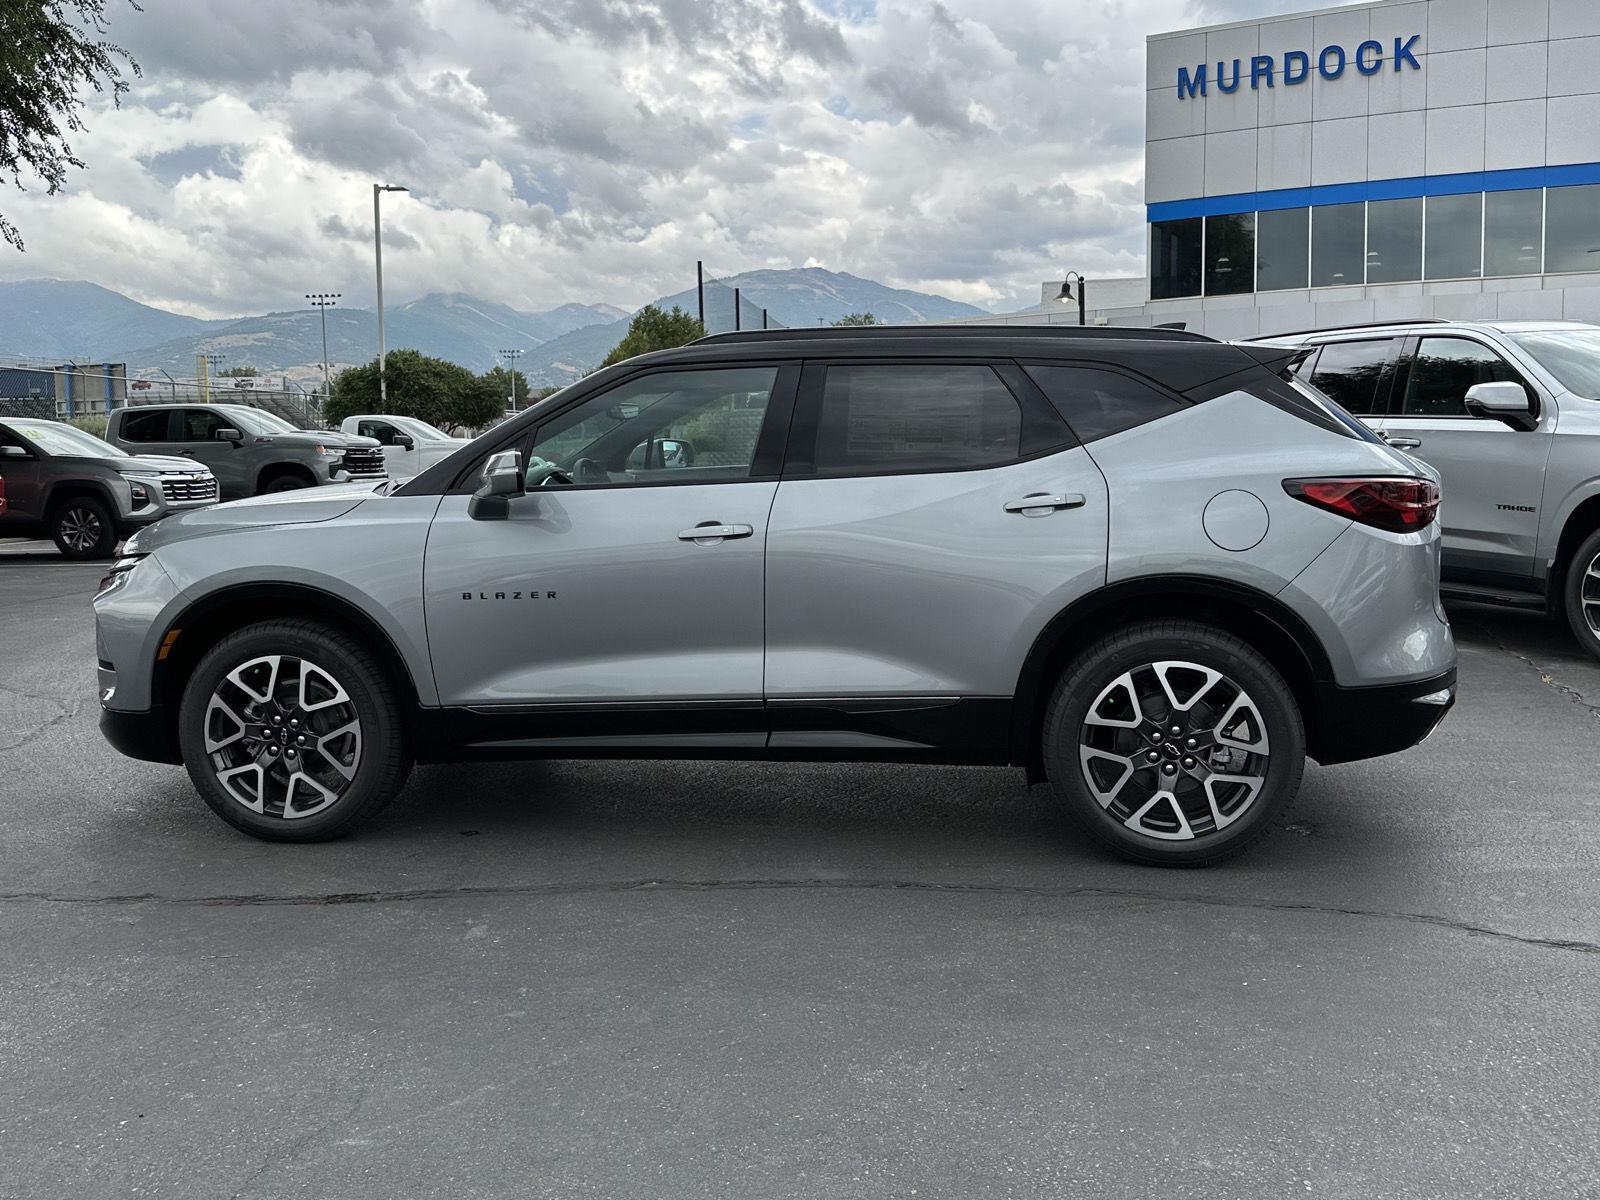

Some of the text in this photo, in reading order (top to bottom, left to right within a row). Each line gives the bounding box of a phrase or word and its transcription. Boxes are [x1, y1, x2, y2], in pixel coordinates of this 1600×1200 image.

[1177, 34, 1421, 100] MURDOCK
[1495, 503, 1536, 513] TAHOE
[462, 591, 557, 600] BLAZER
